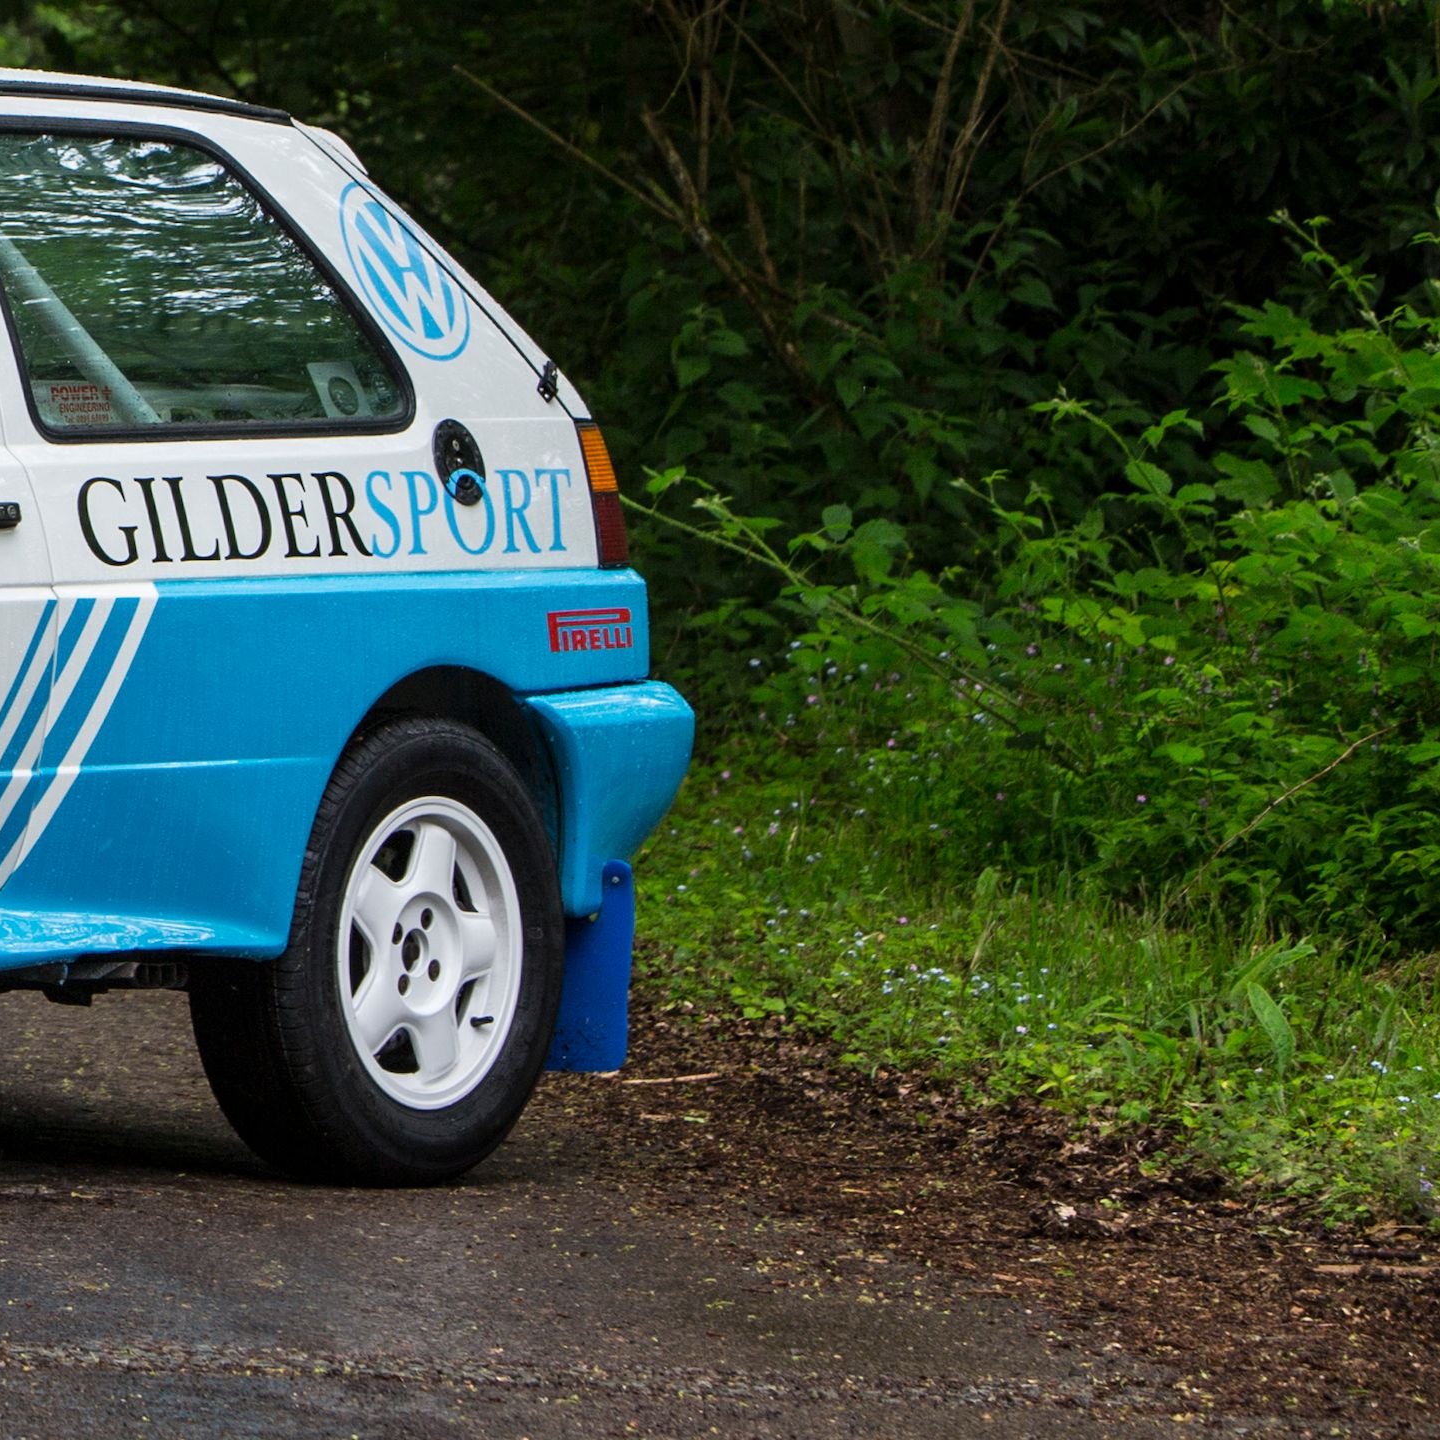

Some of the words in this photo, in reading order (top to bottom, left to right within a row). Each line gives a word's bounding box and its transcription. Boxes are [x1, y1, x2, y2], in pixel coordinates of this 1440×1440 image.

[340, 181, 470, 361] VW
[76, 468, 571, 565] GILDERSPORT
[547, 608, 632, 653] PIRELLI
